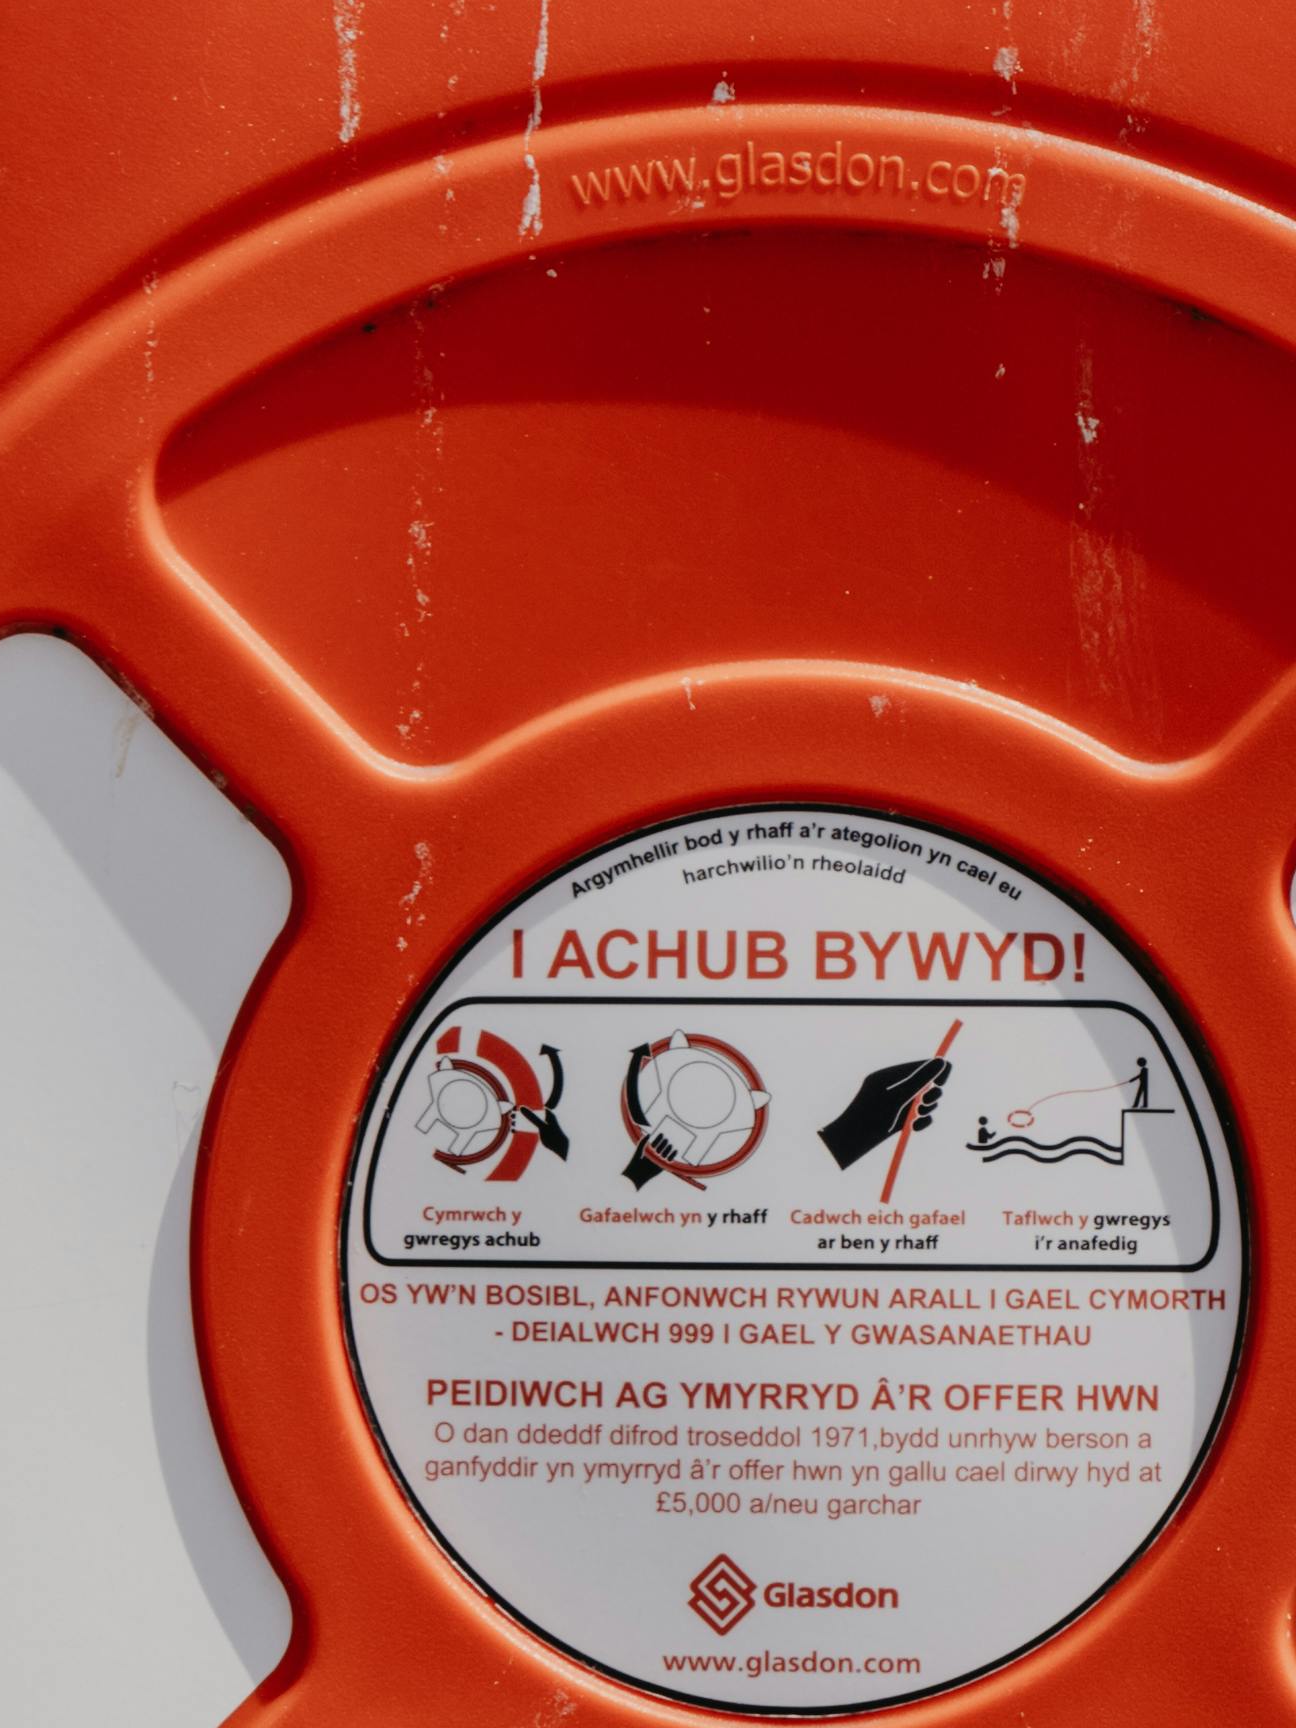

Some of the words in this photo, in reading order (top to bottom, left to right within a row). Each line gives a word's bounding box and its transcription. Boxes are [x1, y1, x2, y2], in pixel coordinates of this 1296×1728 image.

[571, 140, 1027, 204] www.glasdon.com
[569, 837, 679, 899] Argymhellir
[683, 828, 724, 852] bod
[727, 829, 741, 847] y
[746, 821, 794, 841] rhaff
[799, 822, 826, 839] a'r
[830, 826, 923, 857] ategolion
[926, 848, 952, 867] yn
[956, 860, 998, 886] cael
[998, 881, 1022, 901] eu
[682, 854, 805, 885] harchwilio'n
[811, 855, 907, 885] rheolaidd
[512, 928, 524, 979] I
[546, 928, 788, 980] ACHUB
[815, 931, 1086, 983] BYWYD!
[422, 1206, 504, 1226] Cymrwch
[511, 1210, 523, 1227] y
[579, 1207, 675, 1224] Gafaelwch
[679, 1212, 703, 1228] yn
[707, 1212, 718, 1228] y
[722, 1208, 768, 1224] rhaff
[790, 1208, 862, 1226] Cadwch
[867, 1209, 905, 1226] eich
[908, 1209, 966, 1230] gafael
[1002, 1209, 1074, 1226] Taflwch
[1078, 1215, 1089, 1231] y
[1093, 1214, 1171, 1231] gwregys
[403, 1234, 481, 1251] gwregys
[484, 1231, 541, 1247] achub
[817, 1238, 836, 1250] ar
[840, 1234, 875, 1250] ben
[879, 1238, 891, 1254] y
[895, 1234, 939, 1250] rhaff
[1034, 1235, 1053, 1251] i'r
[1056, 1234, 1138, 1255] anafedig
[359, 1282, 398, 1305] OS
[406, 1283, 476, 1306] YW'N
[485, 1284, 595, 1309] BOSIBL,
[603, 1285, 767, 1309] ANFONWCH
[777, 1287, 879, 1309] RYWUN
[888, 1287, 981, 1310] ARALL
[990, 1288, 996, 1310] I
[1005, 1288, 1080, 1310] GAEL
[1089, 1288, 1227, 1312] CYMORTH
[512, 1320, 659, 1344] DEIALWCH
[668, 1322, 715, 1344] 999
[723, 1323, 730, 1345] I
[739, 1323, 815, 1345] GAEL
[824, 1324, 842, 1345] Y
[850, 1323, 1091, 1347] GWASANAETHAU
[427, 1378, 603, 1409] PEIDIWCH
[615, 1381, 668, 1409] AG
[679, 1382, 859, 1411] YMYRRYD
[870, 1376, 932, 1411] Â'R
[944, 1383, 1064, 1412] OFFER
[1077, 1384, 1159, 1412] HWN
[434, 1420, 456, 1444] O
[463, 1422, 509, 1444] dan
[516, 1423, 603, 1446] ddeddf
[608, 1423, 679, 1447] difrod
[686, 1425, 801, 1448] troseddol
[948, 1427, 1037, 1455] unrhyw
[1045, 1427, 1129, 1449] berson
[1137, 1432, 1152, 1449] a
[424, 1455, 539, 1483] ganfyddir
[545, 1461, 575, 1484] yn
[583, 1458, 681, 1486] ymyrryd
[689, 1458, 721, 1481] â'r
[728, 1458, 785, 1481] offer
[792, 1459, 843, 1481] hwn
[851, 1465, 880, 1487] yn
[888, 1460, 947, 1488] gallu
[955, 1460, 1006, 1483] cael
[1014, 1460, 1079, 1488] dirwy
[1087, 1460, 1130, 1488] hyd
[1138, 1462, 1163, 1483] at
[655, 1490, 741, 1516] £5,000
[749, 1492, 818, 1515] a/neu
[826, 1493, 922, 1521] garchar
[763, 1581, 899, 1609] Glasdon
[662, 1649, 921, 1679] www.glasdon.com
